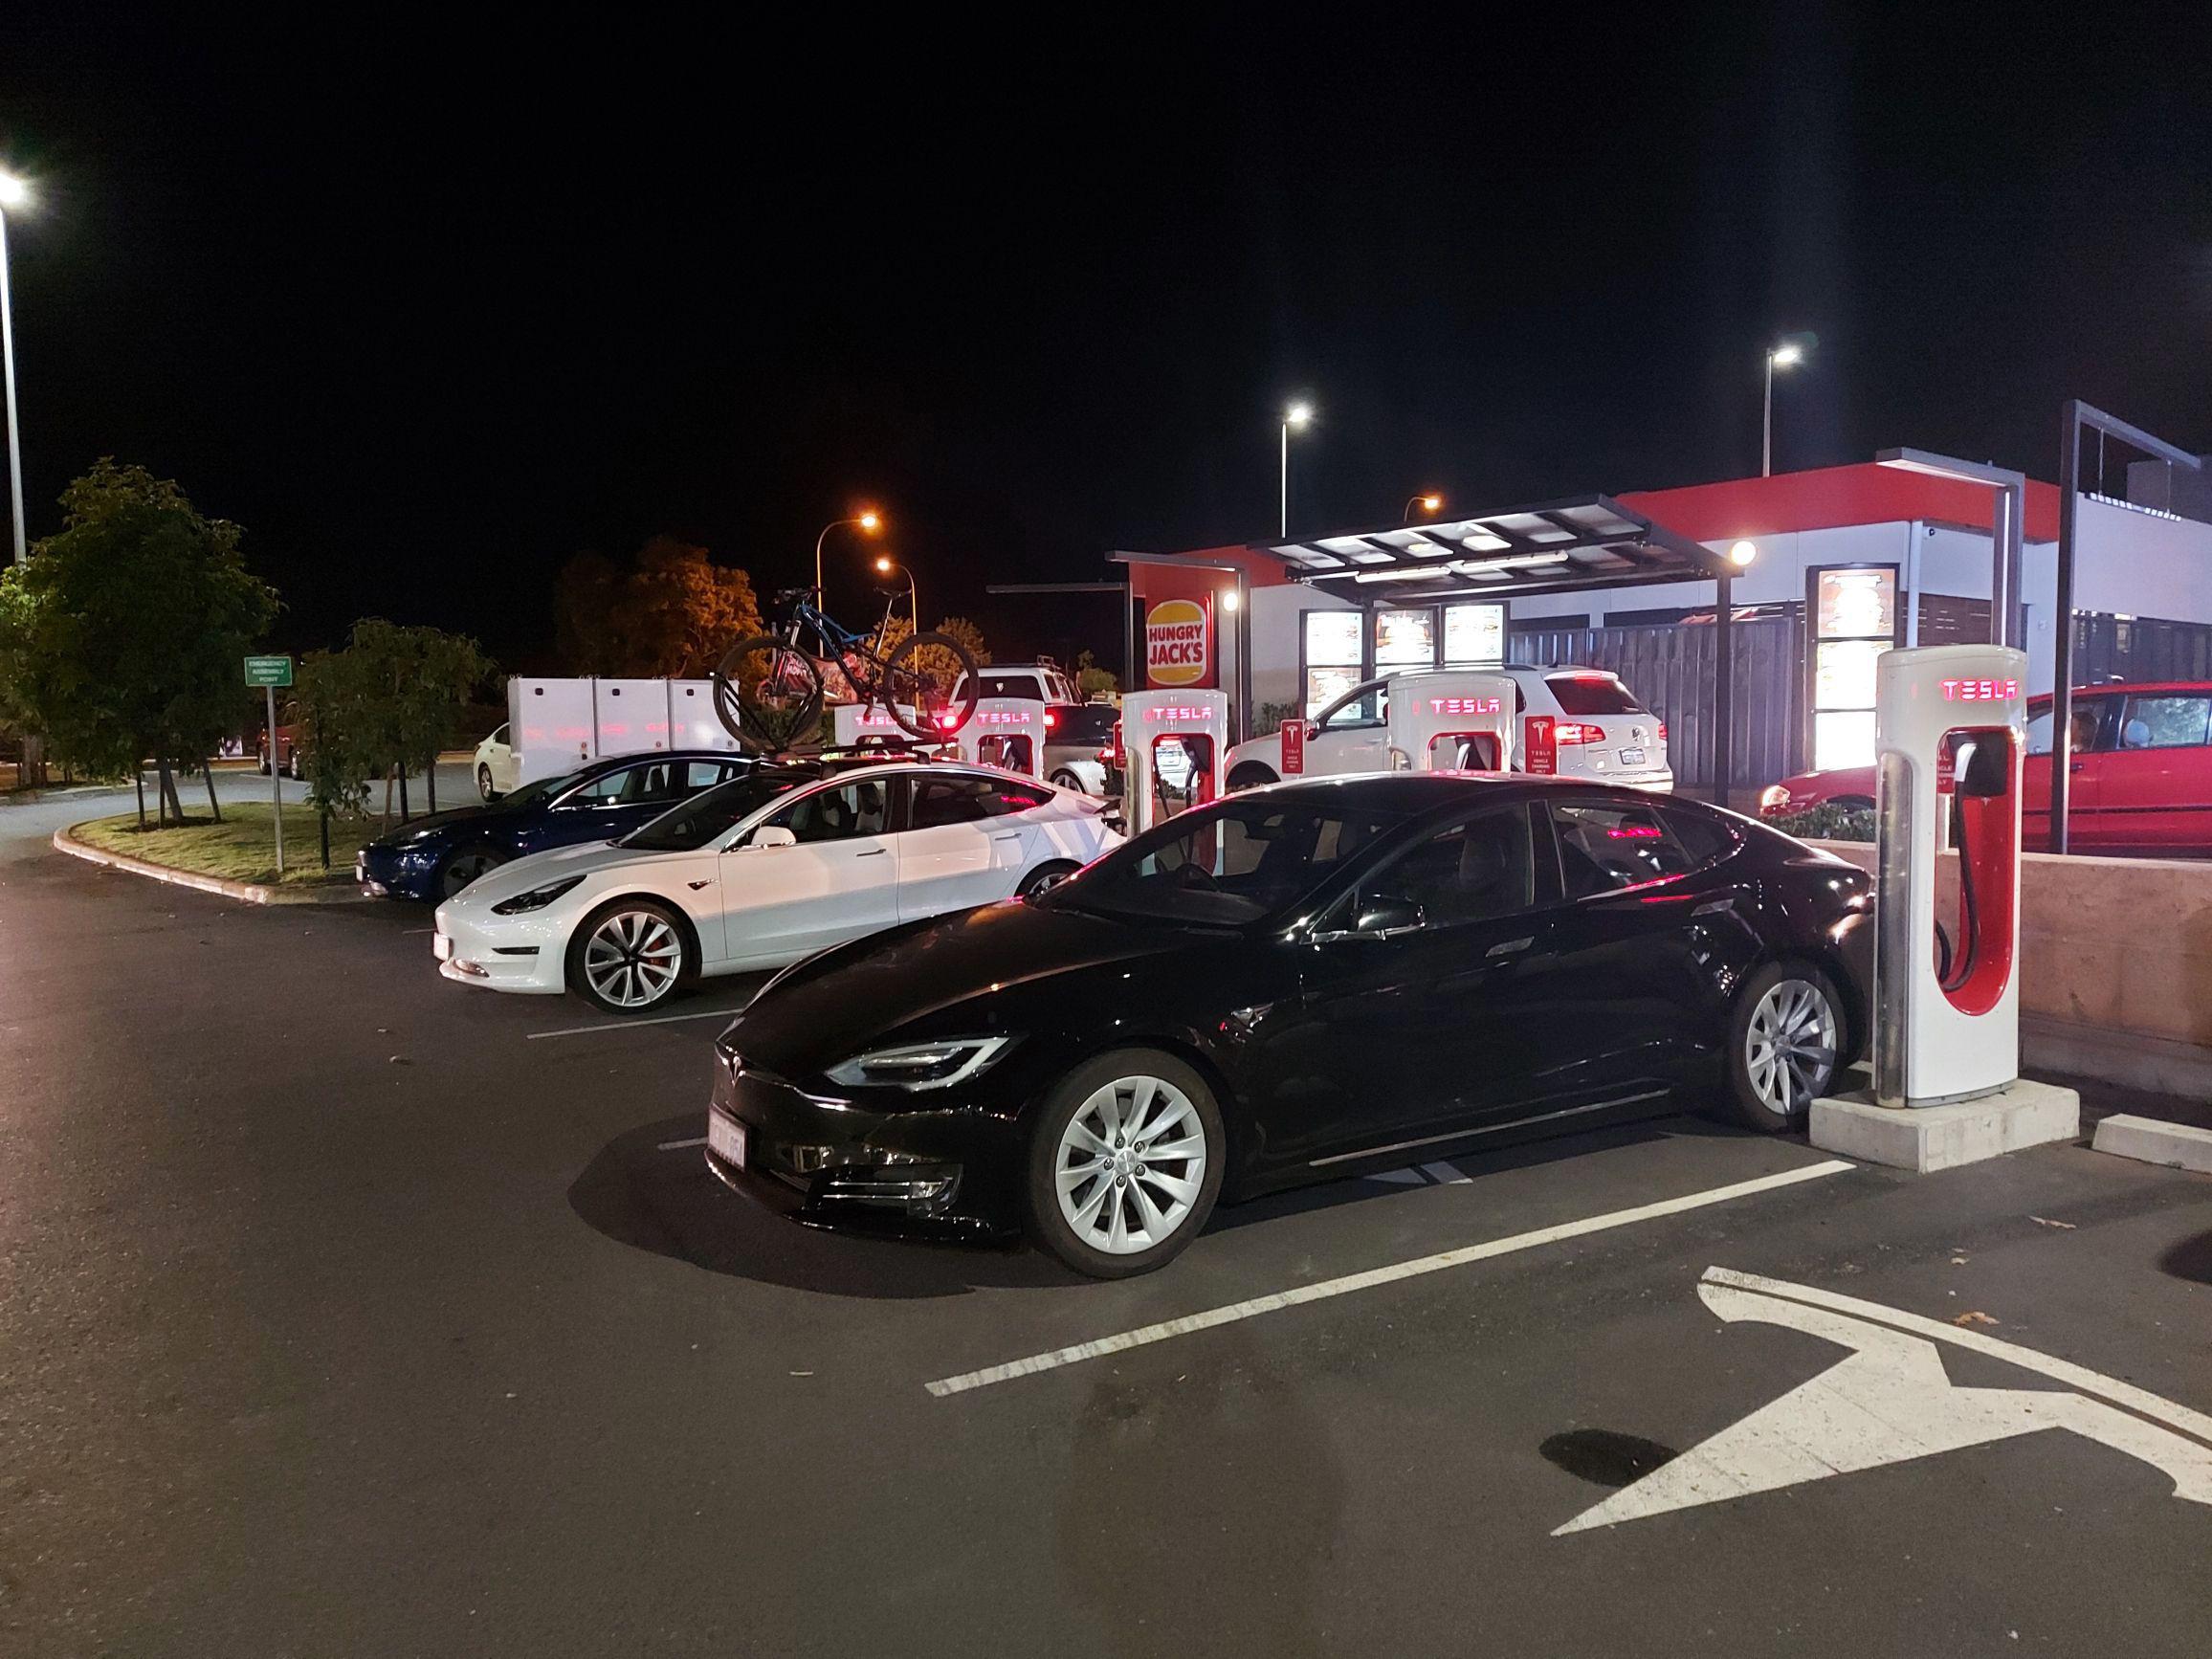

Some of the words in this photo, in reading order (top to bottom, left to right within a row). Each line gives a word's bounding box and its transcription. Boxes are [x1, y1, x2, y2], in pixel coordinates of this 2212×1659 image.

[1149, 625, 1203, 642] HUNGRY
[1149, 642, 1203, 665] JACK'S
[1942, 679, 2018, 699] TESLA
[1152, 707, 1211, 719] TESLA
[1429, 698, 1500, 714] TESLA
[855, 717, 897, 727] TESL
[978, 712, 1030, 723] TESLA
